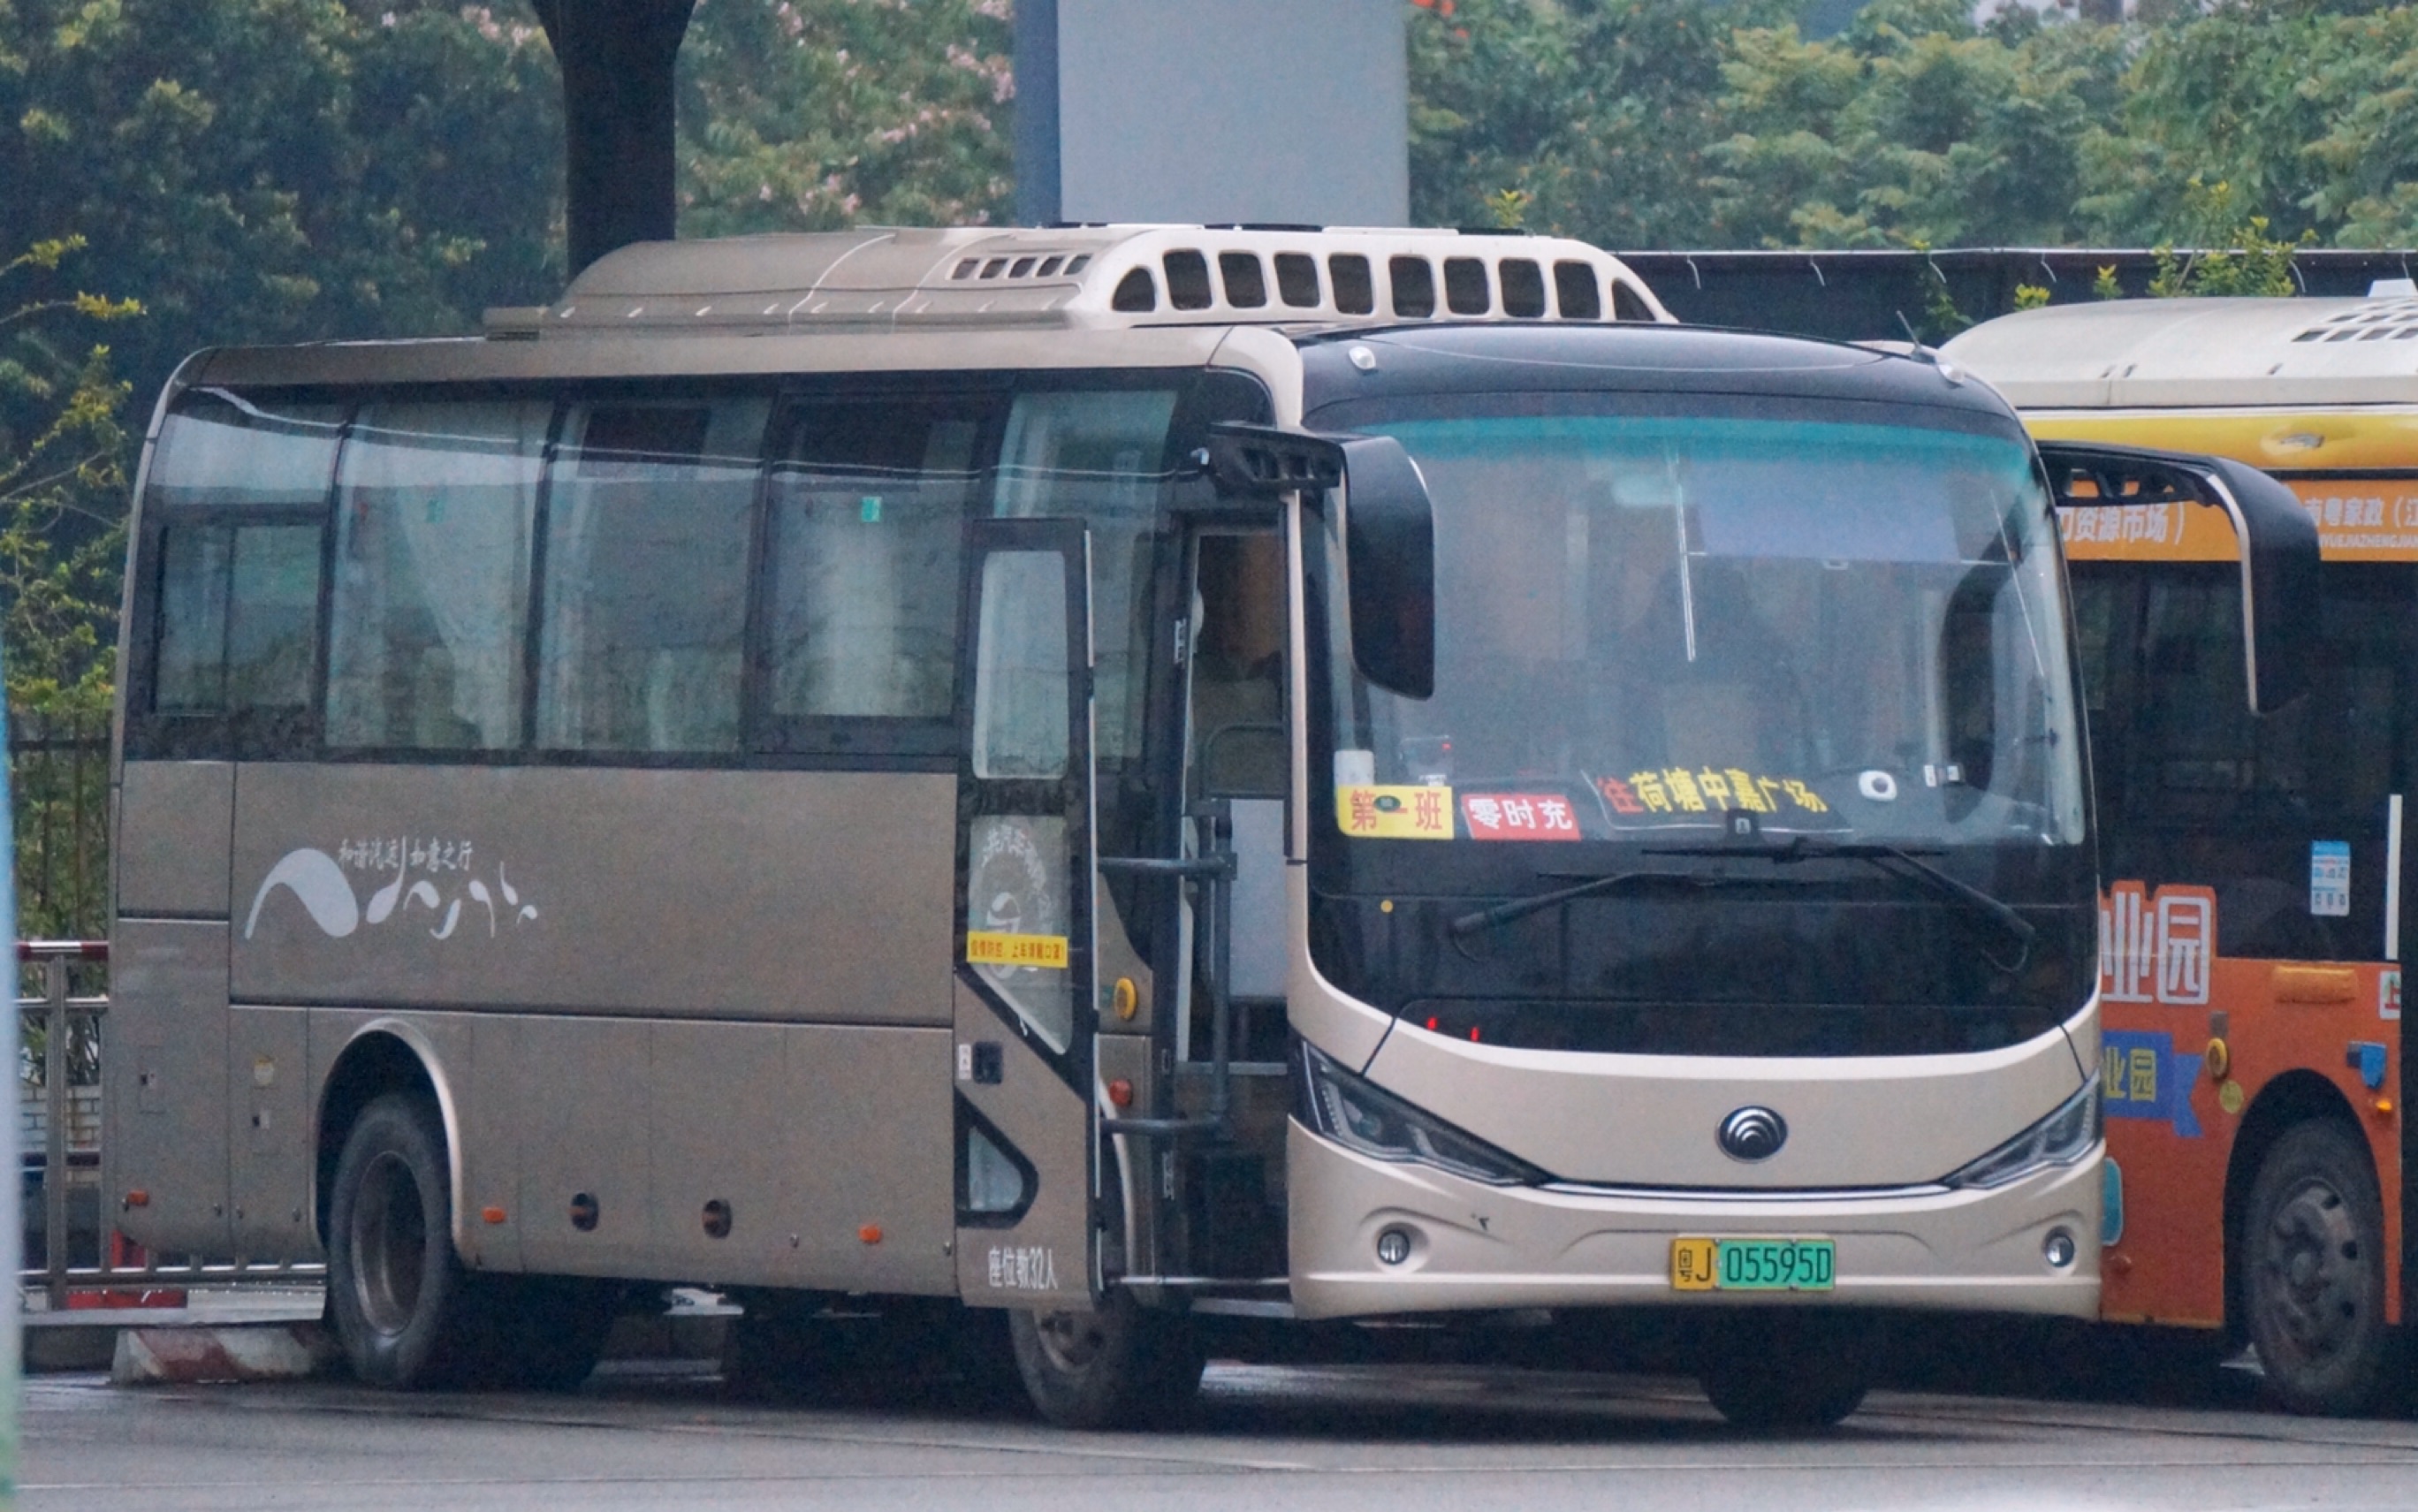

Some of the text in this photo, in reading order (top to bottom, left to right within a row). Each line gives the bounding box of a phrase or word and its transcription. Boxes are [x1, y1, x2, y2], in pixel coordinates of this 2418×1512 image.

[1468, 798, 1573, 831] 零时充
[2101, 891, 2211, 1005] 业园
[988, 1246, 1059, 1290] 座位数32人
[1678, 1247, 1831, 1283] 粤J 05595D
